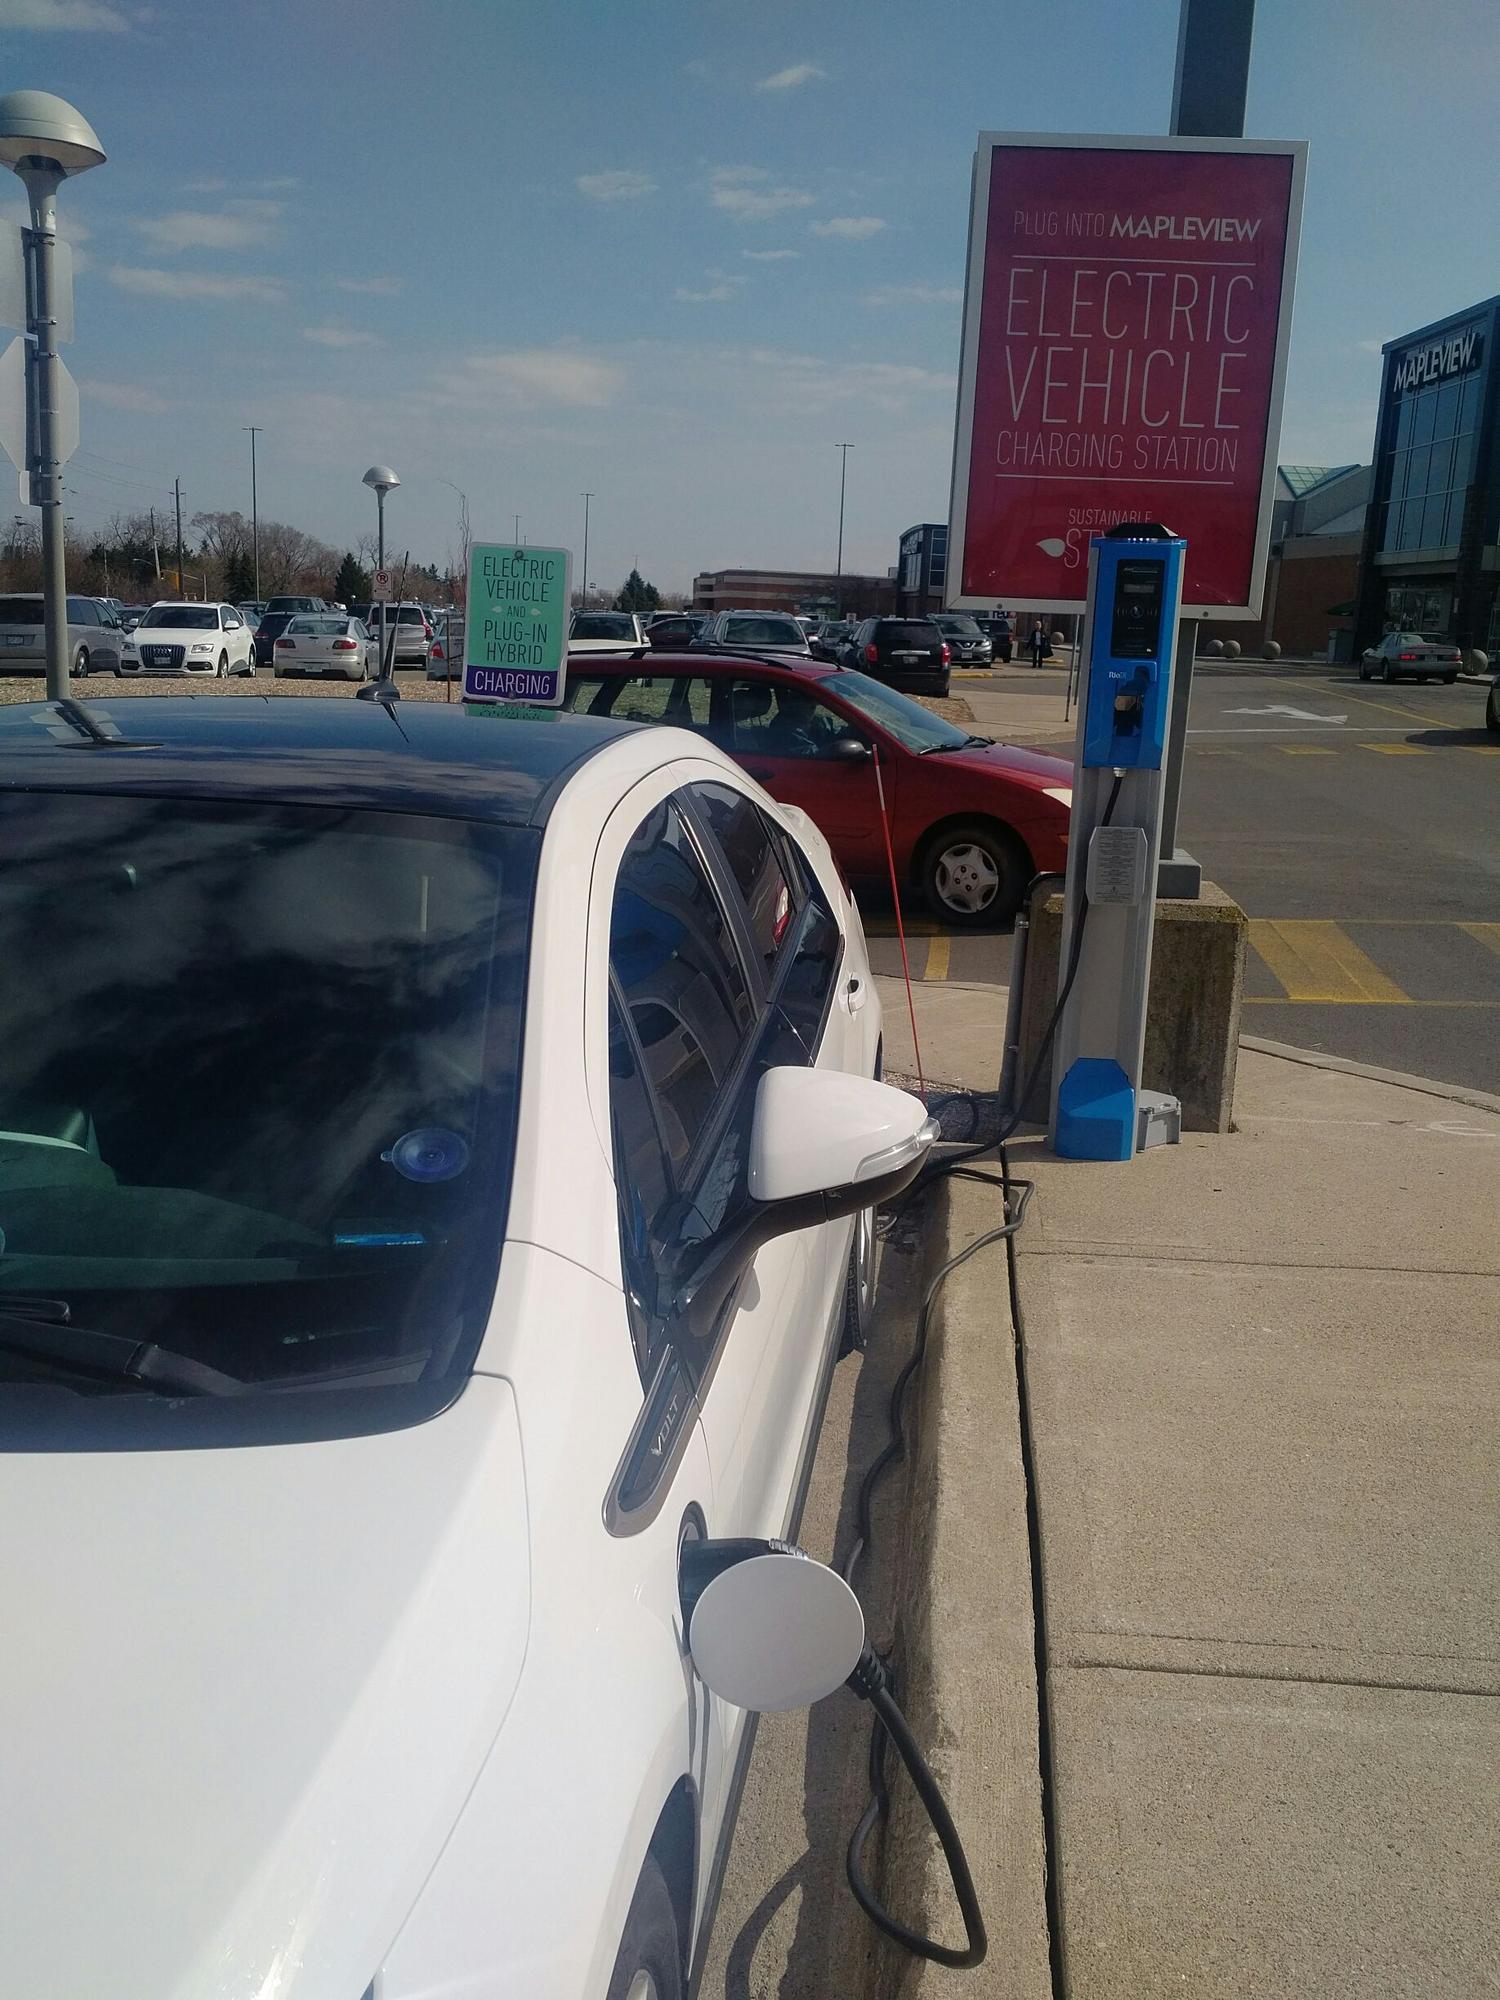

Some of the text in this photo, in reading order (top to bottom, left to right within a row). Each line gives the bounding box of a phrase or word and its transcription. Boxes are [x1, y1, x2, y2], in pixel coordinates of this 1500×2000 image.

[1013, 210, 1262, 242] PLUG INTO MAPLEVIEW
[1006, 268, 1255, 344] ELECTRIC
[1393, 332, 1476, 393] MAPLEVIEW
[1005, 345, 1247, 429] VEHICLE
[996, 430, 1238, 473] CHARGING STATION
[483, 556, 555, 581] ELECTRIC
[486, 578, 549, 603] VEHICLE
[507, 605, 526, 618] AND
[484, 619, 548, 643] PLUG-IN
[487, 642, 543, 665] HYBRID
[474, 670, 550, 695] CHARGING
[650, 1394, 679, 1457] VOLT
